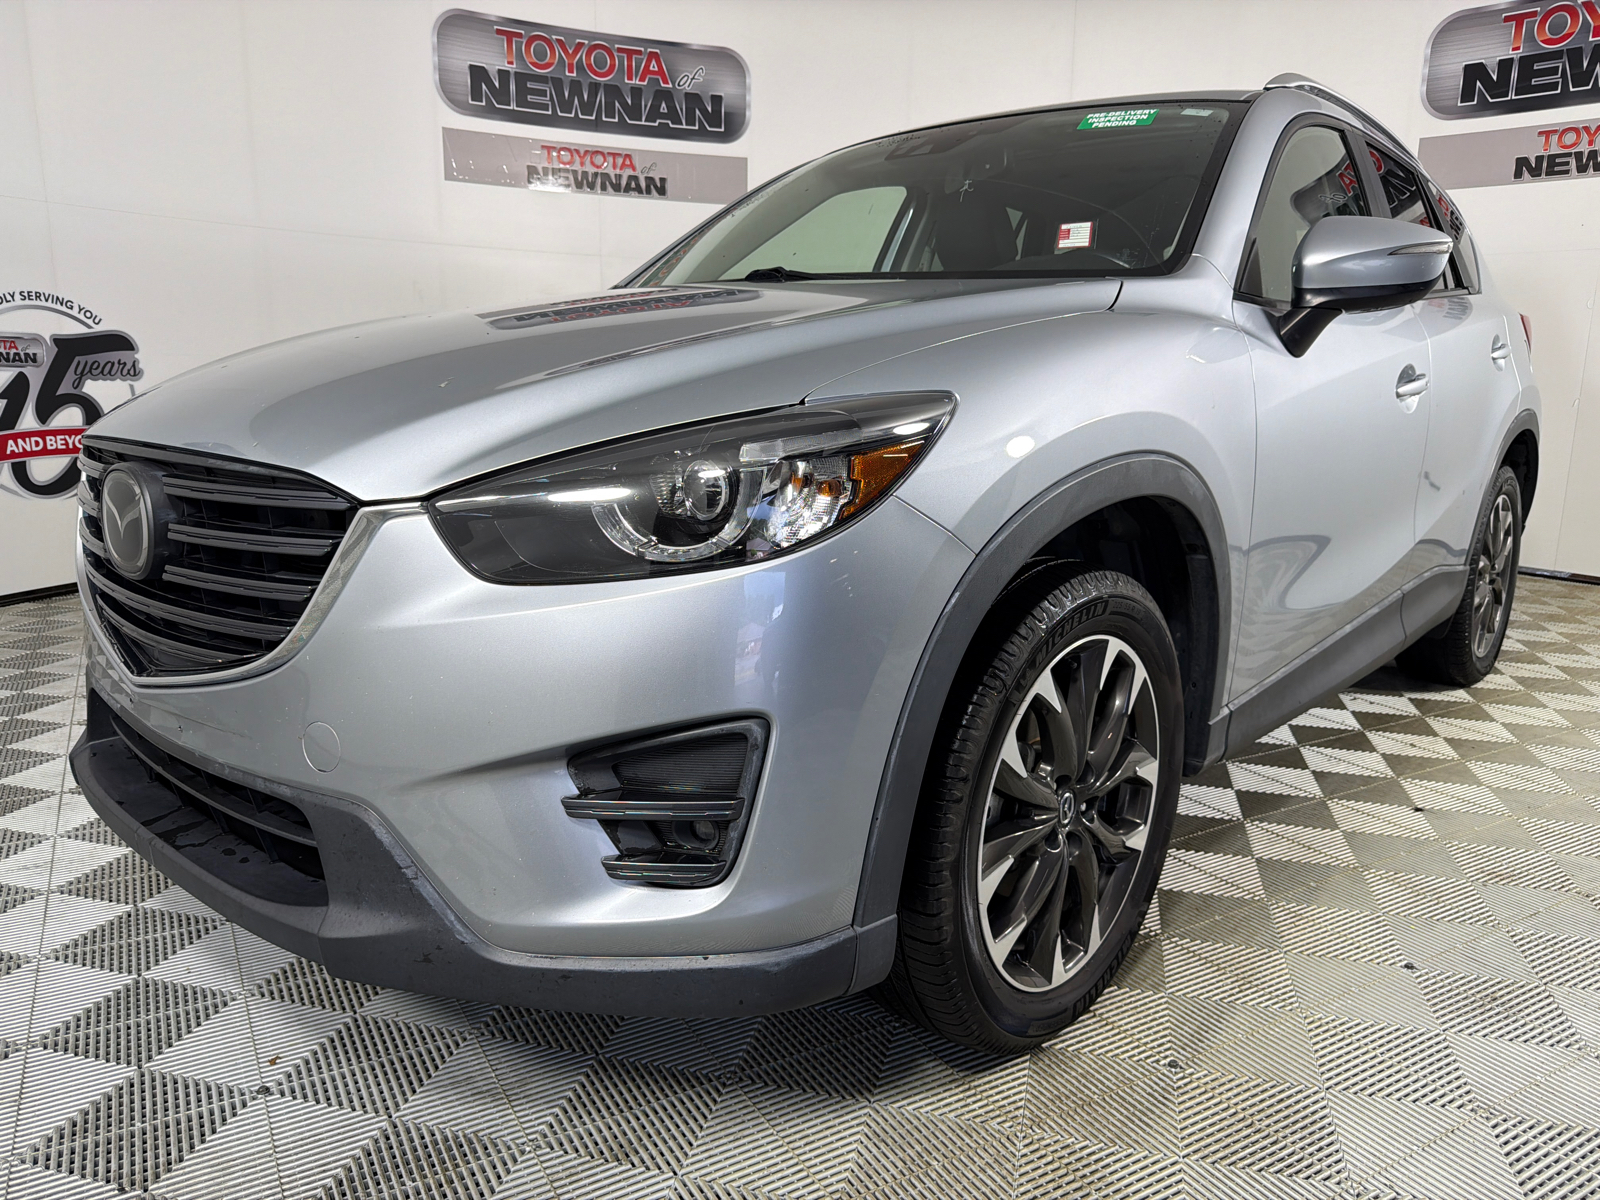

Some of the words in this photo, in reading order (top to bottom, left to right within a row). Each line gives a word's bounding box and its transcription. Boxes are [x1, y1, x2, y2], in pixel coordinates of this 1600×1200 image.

[494, 26, 672, 87] TOYOTA
[675, 66, 705, 90] of
[468, 63, 725, 132] NEWNAN
[1086, 109, 1157, 119] PRE-DELIVERY
[1088, 114, 1148, 123] INSPECTION
[1091, 120, 1137, 128] PENDING
[540, 145, 637, 173] TOYOTA
[640, 163, 657, 175] of
[526, 165, 668, 198] NEWNAN
[19, 290, 74, 311] SERVING
[77, 304, 103, 326] YOU
[72, 358, 142, 390] years
[6, 436, 44, 455] AND
[1036, 600, 1108, 667] MICHELIN
